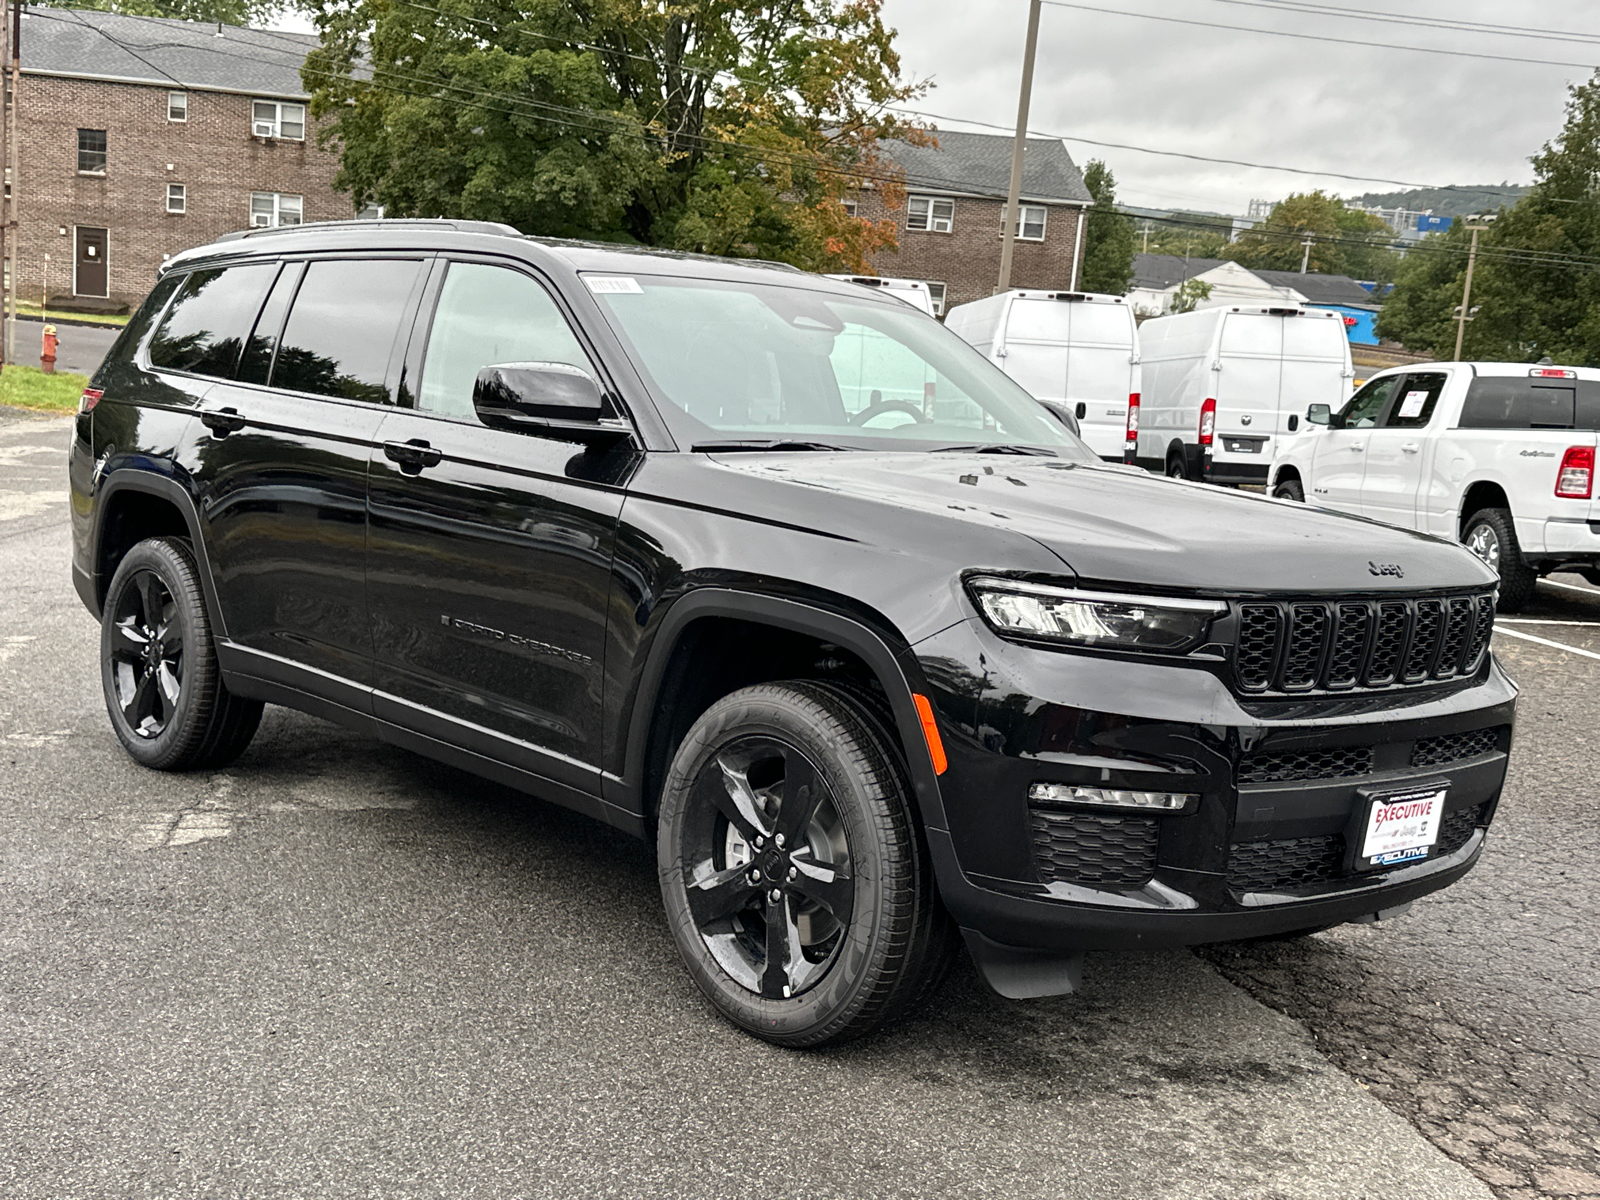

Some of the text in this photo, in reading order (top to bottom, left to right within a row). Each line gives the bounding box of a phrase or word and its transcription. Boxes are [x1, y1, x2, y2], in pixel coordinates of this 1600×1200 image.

[1368, 561, 1404, 579] Jeep
[454, 618, 593, 667] GRAND CHEROKEE
[1375, 801, 1433, 831] EXECUTIVE
[1369, 846, 1430, 865] EXECUTIVE
